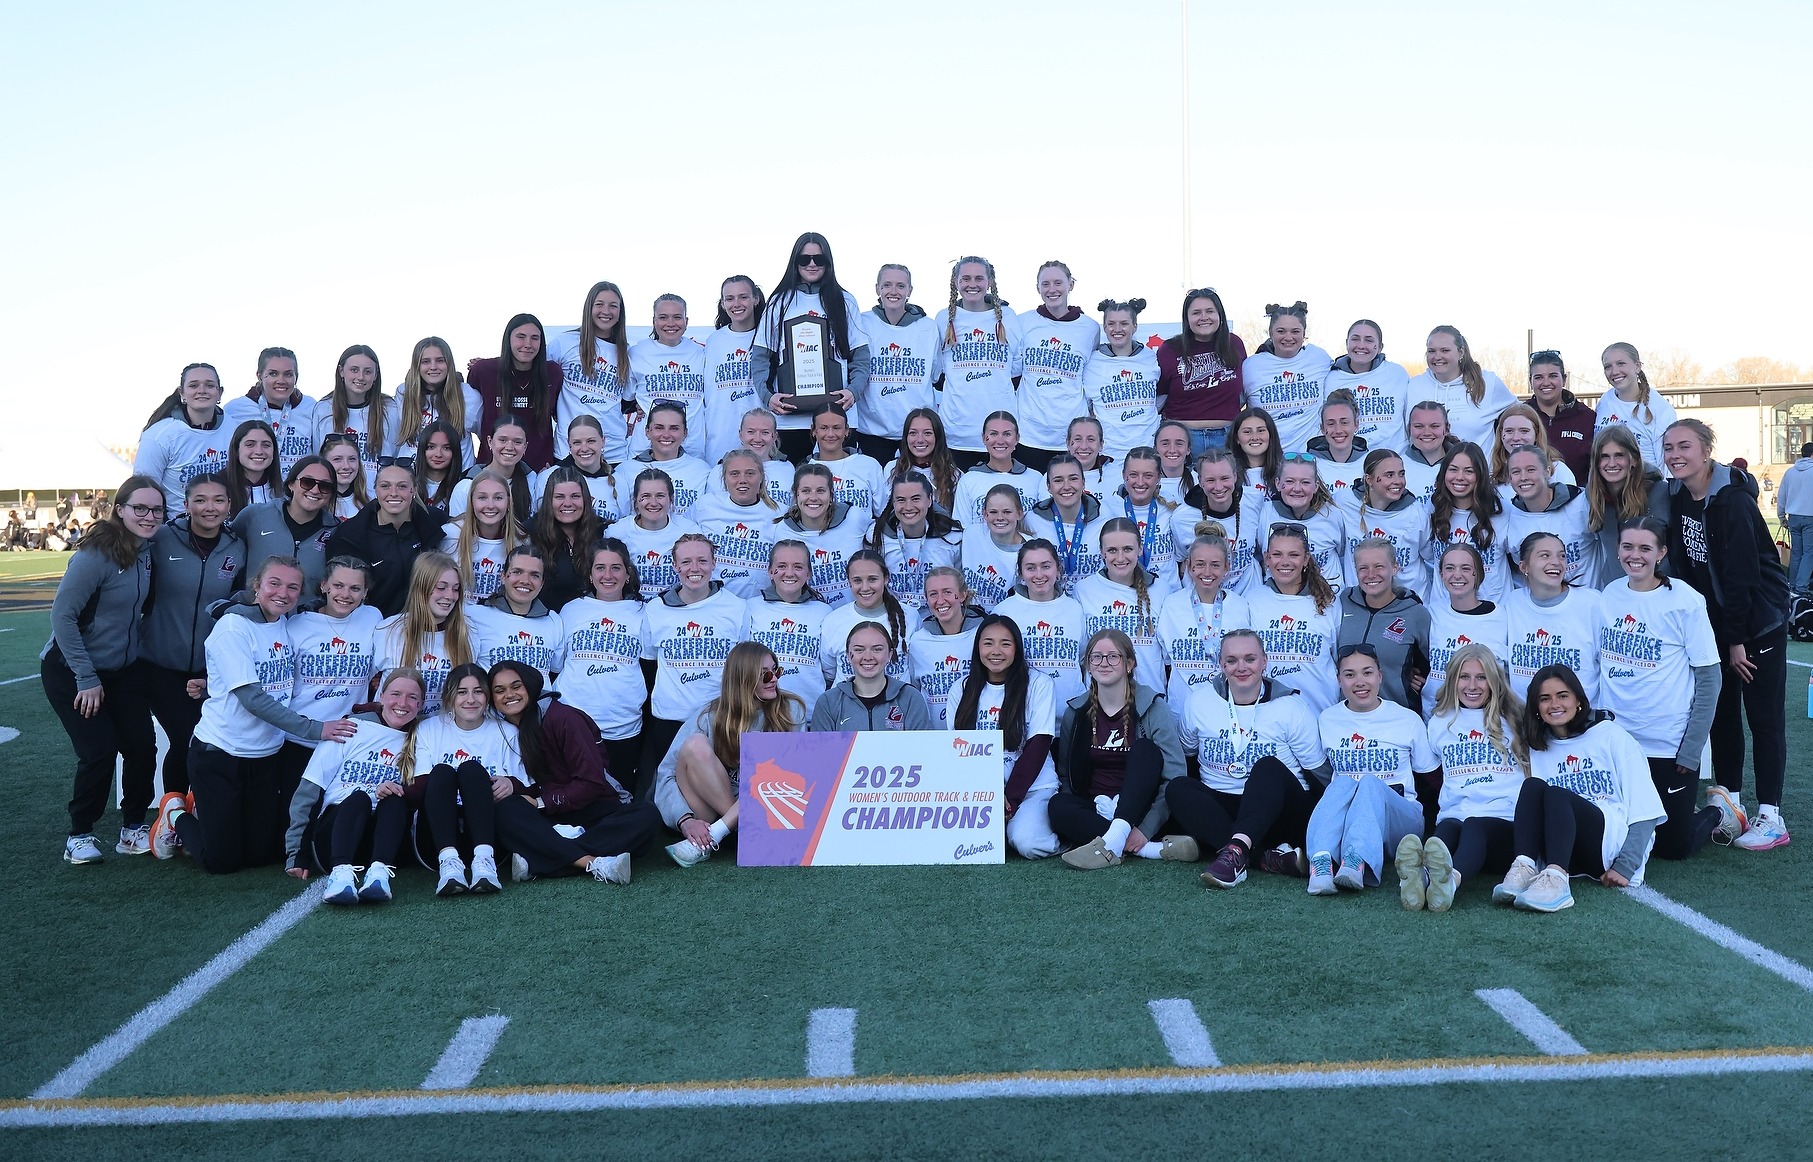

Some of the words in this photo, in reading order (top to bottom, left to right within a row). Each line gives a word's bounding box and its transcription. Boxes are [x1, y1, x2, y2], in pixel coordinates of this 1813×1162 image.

[964, 333, 972, 341] 24
[987, 333, 995, 341] 25
[1041, 339, 1048, 347] 24
[903, 348, 911, 356] 25
[952, 351, 1008, 362] CHAMPIONS
[1025, 348, 1083, 363] CONFERENCE
[871, 357, 925, 368] ONFERENCE
[1025, 356, 1081, 373] CHAMPIONS
[610, 365, 617, 373] 25
[871, 366, 925, 376] HAMPIONS
[966, 370, 992, 382] Culver's
[1113, 375, 1121, 383] 24
[1135, 372, 1143, 380] 25
[1274, 375, 1282, 383] 24
[1297, 373, 1304, 381] 25
[1037, 377, 1062, 387] Culver's
[881, 385, 907, 396] Culver's
[1259, 381, 1319, 395] CONFERENCE
[1371, 388, 1379, 396] 25
[1260, 390, 1319, 403] CHAMPIONS
[1121, 408, 1145, 421] Culver's
[287, 427, 295, 435] 25
[1355, 424, 1378, 435] ulver's
[358, 433, 367, 441] 25
[199, 454, 206, 462] 24
[220, 451, 227, 459] 25
[846, 480, 854, 488] 25
[1326, 484, 1334, 492] 24
[598, 500, 606, 508] 25
[725, 526, 734, 535] 24
[750, 530, 759, 539] 25
[1239, 539, 1247, 548] 25
[1389, 535, 1397, 544] 25
[1079, 544, 1088, 553] 25
[637, 555, 646, 564] 24
[831, 551, 841, 560] 25
[899, 563, 908, 572] 24
[720, 568, 749, 579] Culver's
[977, 564, 986, 574] 24
[999, 577, 1007, 588] 25
[1102, 606, 1112, 614] 24
[1130, 606, 1139, 614] 25
[590, 622, 600, 630] 24
[618, 624, 627, 632] 25
[770, 622, 780, 630] 24
[798, 624, 808, 633] 25
[1270, 619, 1279, 628] 24
[1298, 621, 1307, 630] 25
[1613, 618, 1623, 628] 24
[1637, 623, 1646, 633] 25
[676, 627, 686, 636] 24
[704, 626, 713, 636] 25
[1026, 626, 1036, 636] 24
[1054, 626, 1064, 635] 25
[1188, 628, 1197, 637] 24
[508, 635, 518, 644] 24
[535, 636, 544, 645] 25
[1258, 630, 1322, 645] ONFERENCE
[1446, 638, 1456, 648] 24
[1526, 633, 1535, 643] 24
[1552, 635, 1561, 645] 25
[320, 643, 330, 652] 24
[350, 643, 360, 653] 25
[660, 637, 731, 650] CONFERENCE
[1024, 637, 1078, 651] NFERENCE
[1266, 641, 1321, 656] AMPIONS
[268, 648, 276, 658] 24
[1512, 643, 1580, 659] CONFERENCE
[441, 659, 450, 669] 25
[935, 661, 944, 671] 24
[962, 660, 971, 669] 25
[587, 664, 619, 677] Culver's
[1271, 664, 1301, 678] Culver's
[1609, 667, 1635, 678] Culver's
[680, 670, 711, 684] Culver's
[315, 688, 350, 700] Culver's
[980, 710, 987, 719] 24
[1219, 729, 1228, 739] 24
[1458, 733, 1468, 741] 24
[1340, 738, 1349, 747] 24
[1368, 739, 1378, 747] 25
[955, 742, 994, 757] WIAC
[368, 751, 379, 762] 24
[443, 753, 453, 763] 24
[1558, 762, 1566, 773] 24
[1583, 758, 1593, 769] 25
[852, 765, 922, 788] 2025
[849, 792, 888, 803] WOMEN'S
[891, 792, 931, 802] OUTDOOR
[934, 792, 960, 802] TRACK
[963, 792, 968, 802] &
[972, 792, 995, 802] FIELD
[841, 806, 993, 830] CHAMPIONS
[954, 841, 995, 860] Culver's
